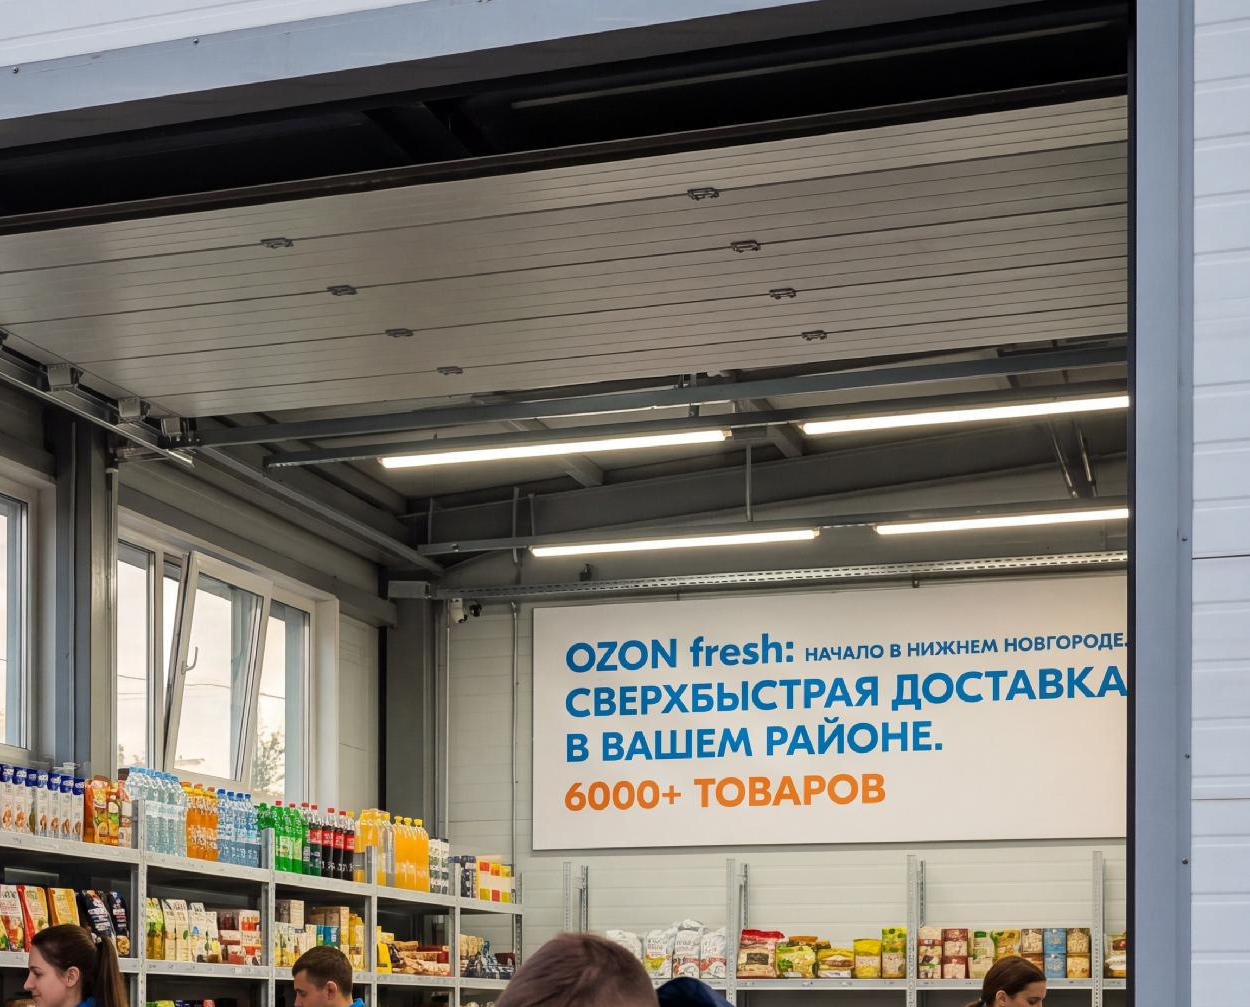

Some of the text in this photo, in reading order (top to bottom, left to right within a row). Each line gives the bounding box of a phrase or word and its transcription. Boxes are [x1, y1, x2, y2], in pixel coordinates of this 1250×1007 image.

[565, 632, 794, 673] OZON fresh:
[805, 643, 884, 661] НАЧАЛО
[889, 643, 902, 658] В
[906, 638, 998, 657] НИЖНЕМ
[565, 665, 1128, 718] СВЕРХБЫСТРАЯ ДОСТАВКА
[566, 716, 943, 763] В ВАШЕМ РАЙОНЕ.
[564, 773, 886, 812] 6000+ ТОВАРОВ
